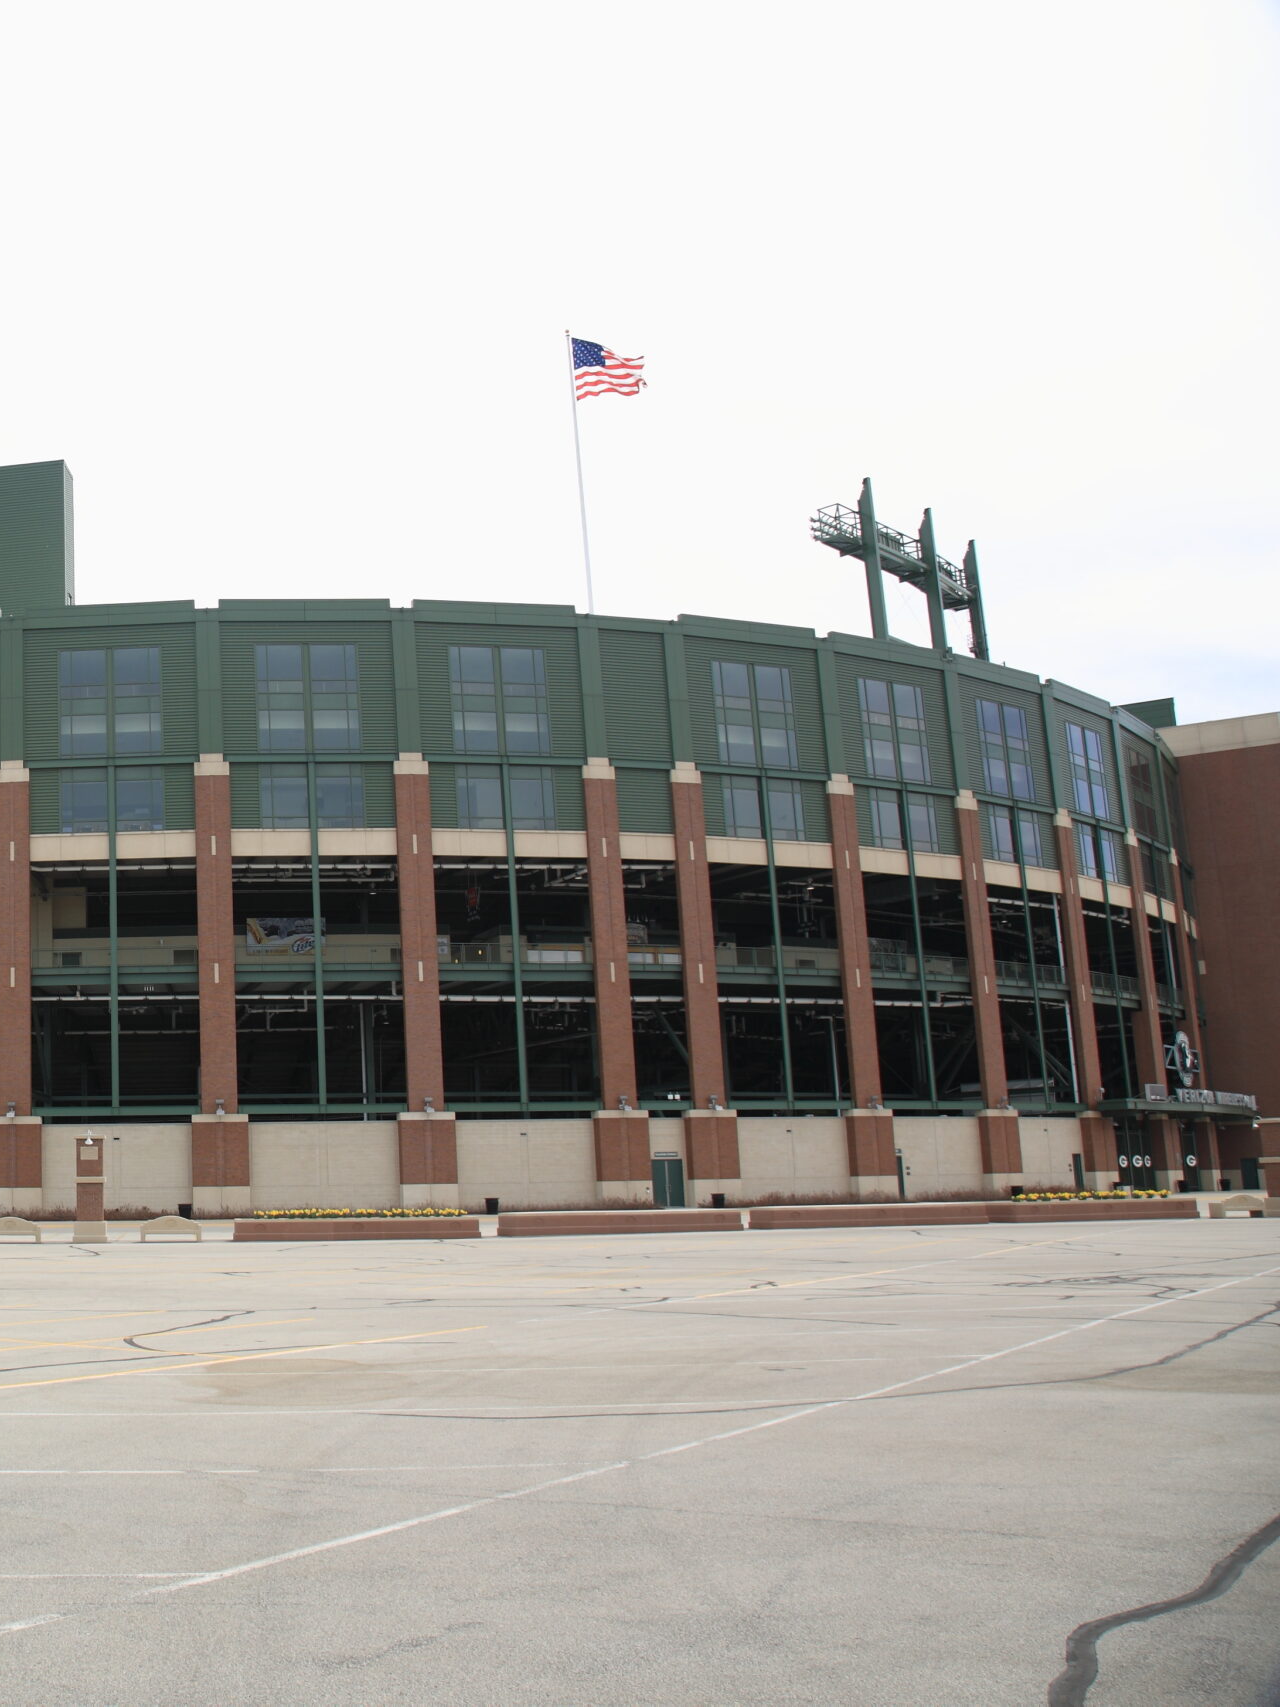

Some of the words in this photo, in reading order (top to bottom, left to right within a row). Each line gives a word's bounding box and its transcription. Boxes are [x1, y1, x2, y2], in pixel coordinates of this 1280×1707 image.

[1119, 1155, 1128, 1168] G
[1132, 1155, 1143, 1168] G
[1144, 1155, 1151, 1168] G
[1186, 1154, 1197, 1167] G
